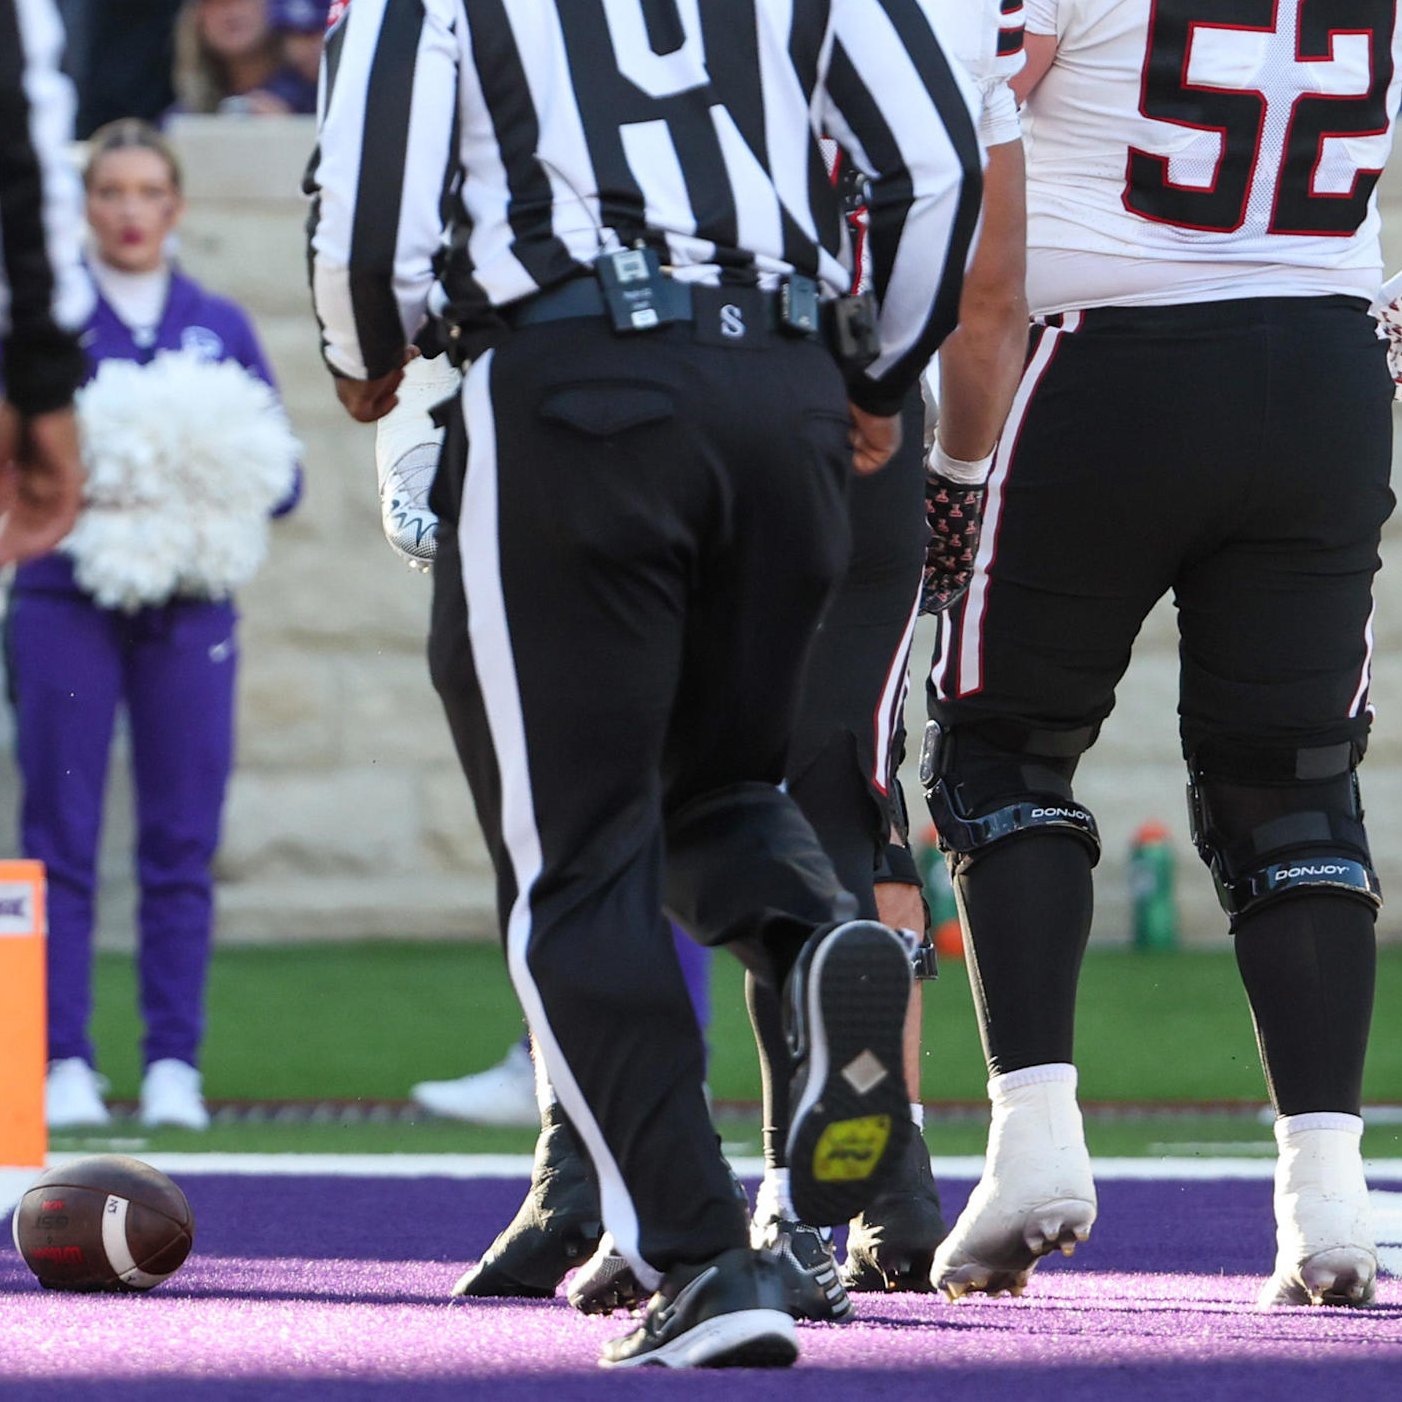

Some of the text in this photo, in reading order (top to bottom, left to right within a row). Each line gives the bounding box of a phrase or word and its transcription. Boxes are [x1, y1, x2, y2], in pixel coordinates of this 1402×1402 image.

[719, 304, 745, 338] S
[1031, 808, 1091, 821] DONJOY
[1275, 865, 1345, 880] DONJOY
